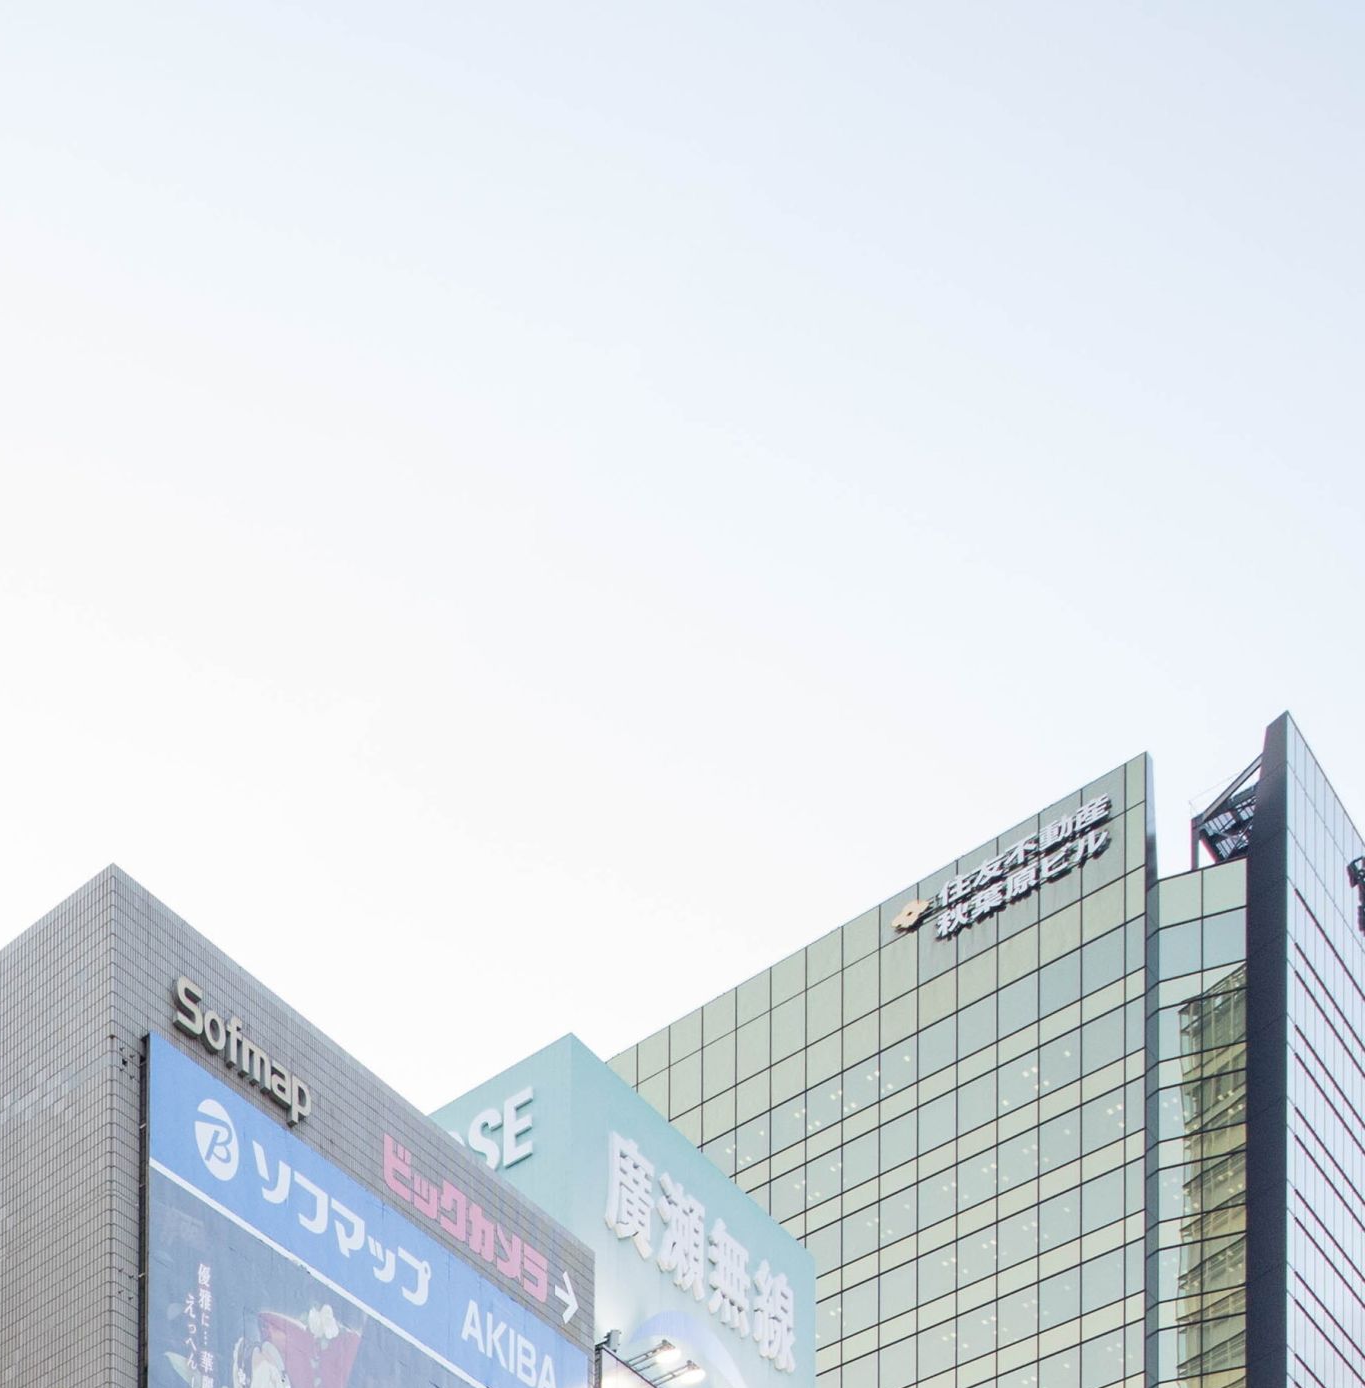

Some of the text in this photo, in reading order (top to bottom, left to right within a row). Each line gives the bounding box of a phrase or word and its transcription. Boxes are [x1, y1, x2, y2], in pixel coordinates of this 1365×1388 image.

[938, 793, 1114, 908] 住友不動産
[173, 976, 313, 1126] Sofmap
[251, 1136, 433, 1307] ソフマップ
[383, 1132, 549, 1303] ビックカメラ
